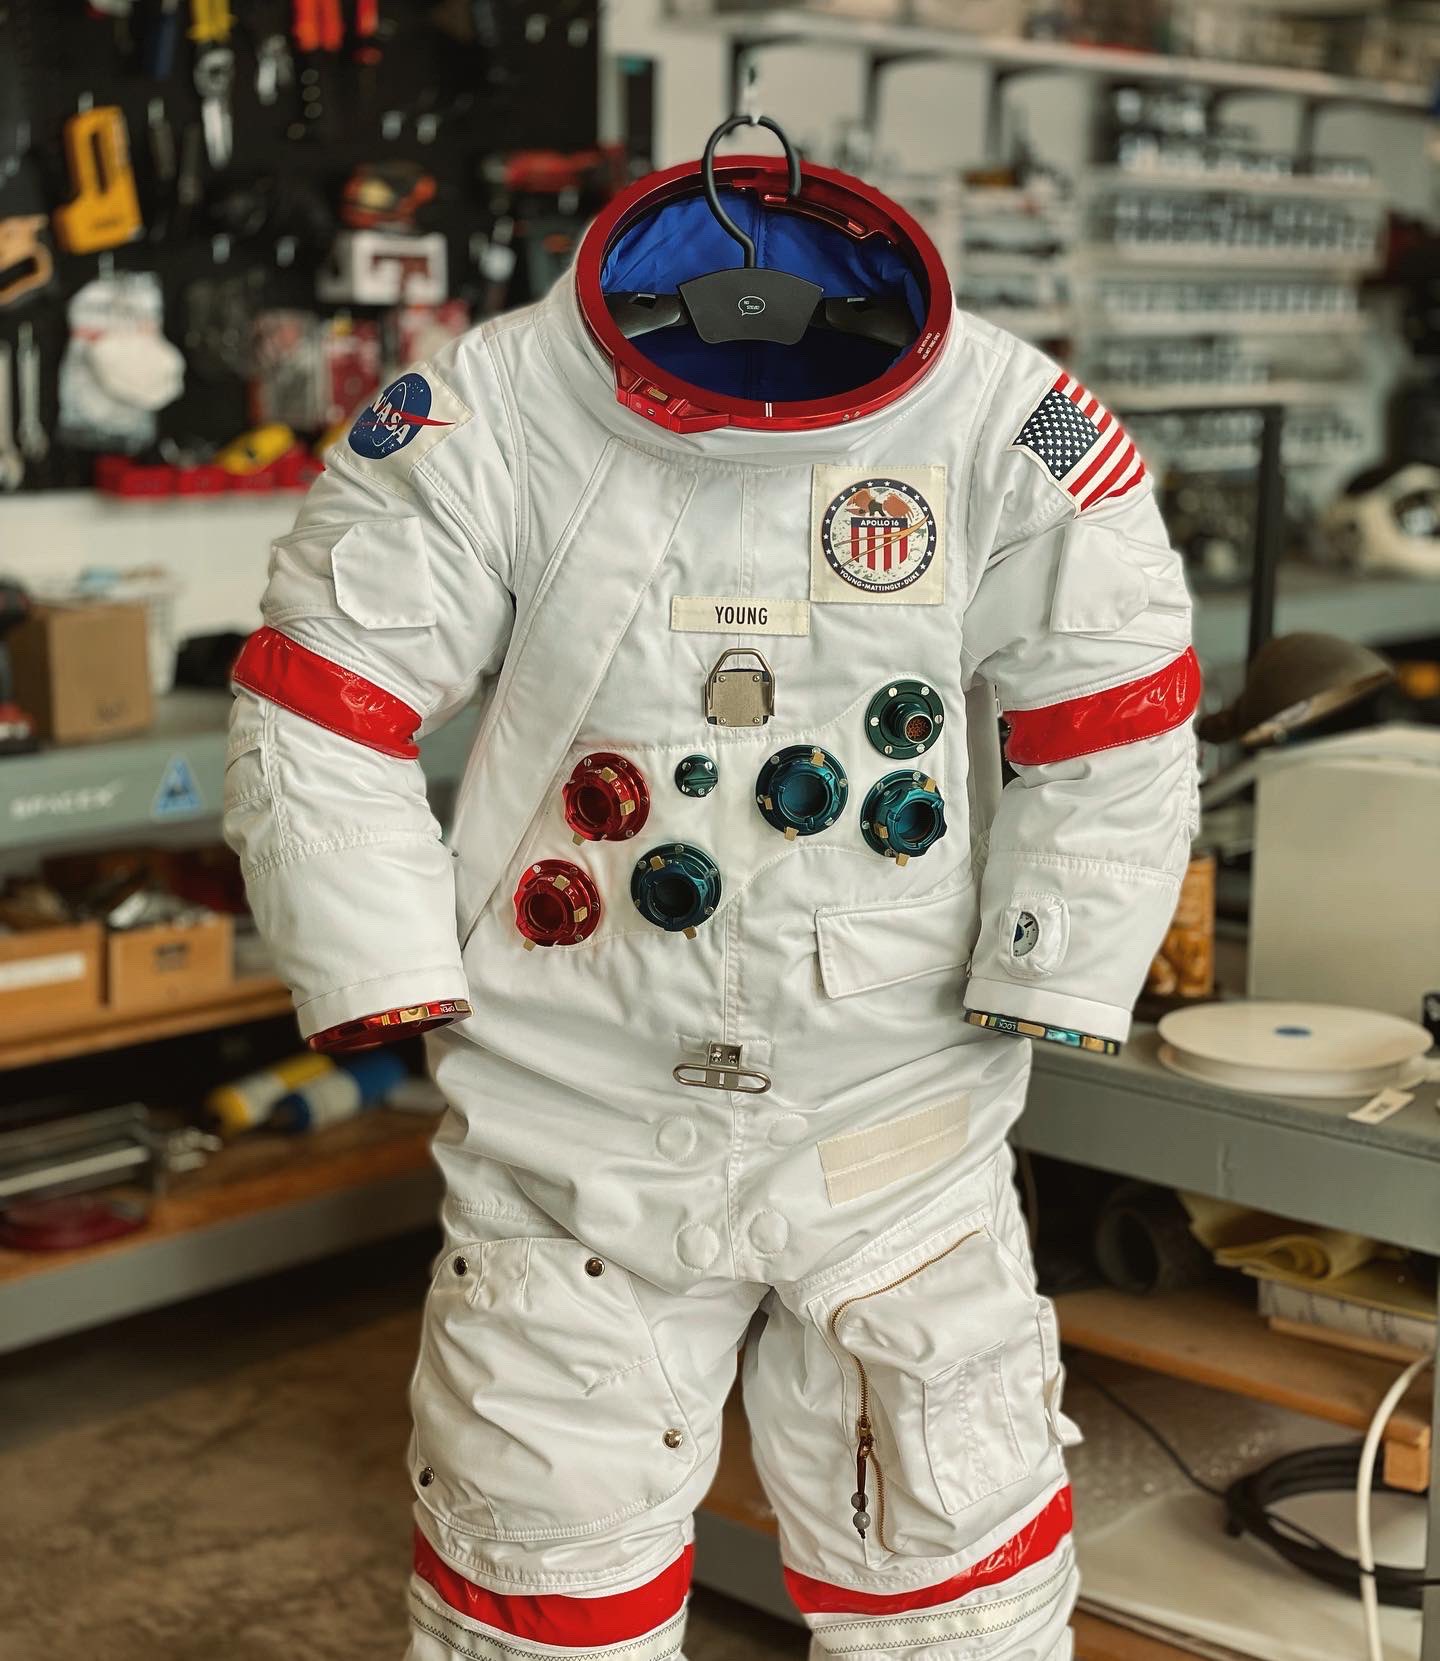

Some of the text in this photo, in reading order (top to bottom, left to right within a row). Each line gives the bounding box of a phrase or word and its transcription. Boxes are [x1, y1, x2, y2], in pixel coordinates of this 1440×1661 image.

[372, 393, 411, 445] NASA
[860, 519, 900, 527] APOLLO 16
[715, 606, 768, 625] YOUNG
[998, 1021, 1016, 1031] LOCK
